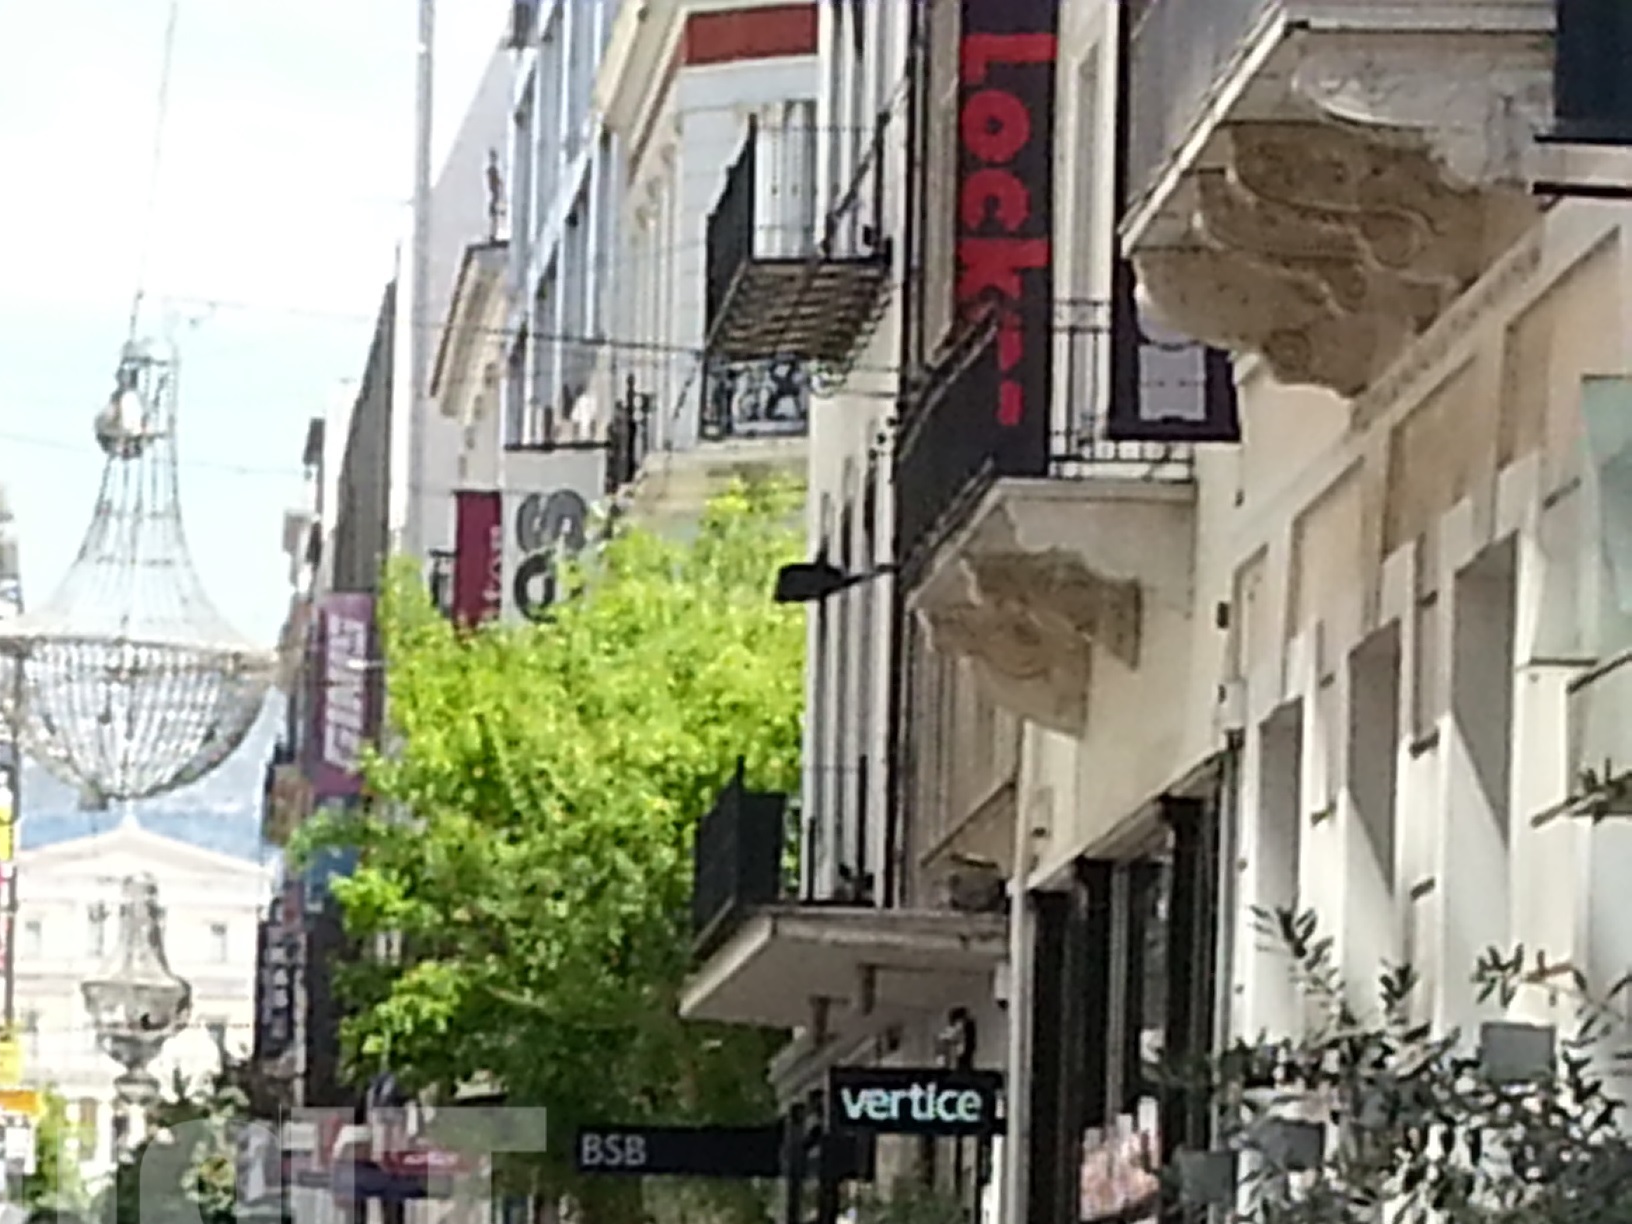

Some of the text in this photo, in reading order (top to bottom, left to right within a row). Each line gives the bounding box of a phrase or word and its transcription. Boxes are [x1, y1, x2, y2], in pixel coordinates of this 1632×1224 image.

[960, 32, 1057, 427] Lock
[840, 1084, 984, 1123] vertice
[580, 1133, 648, 1168] BSB
